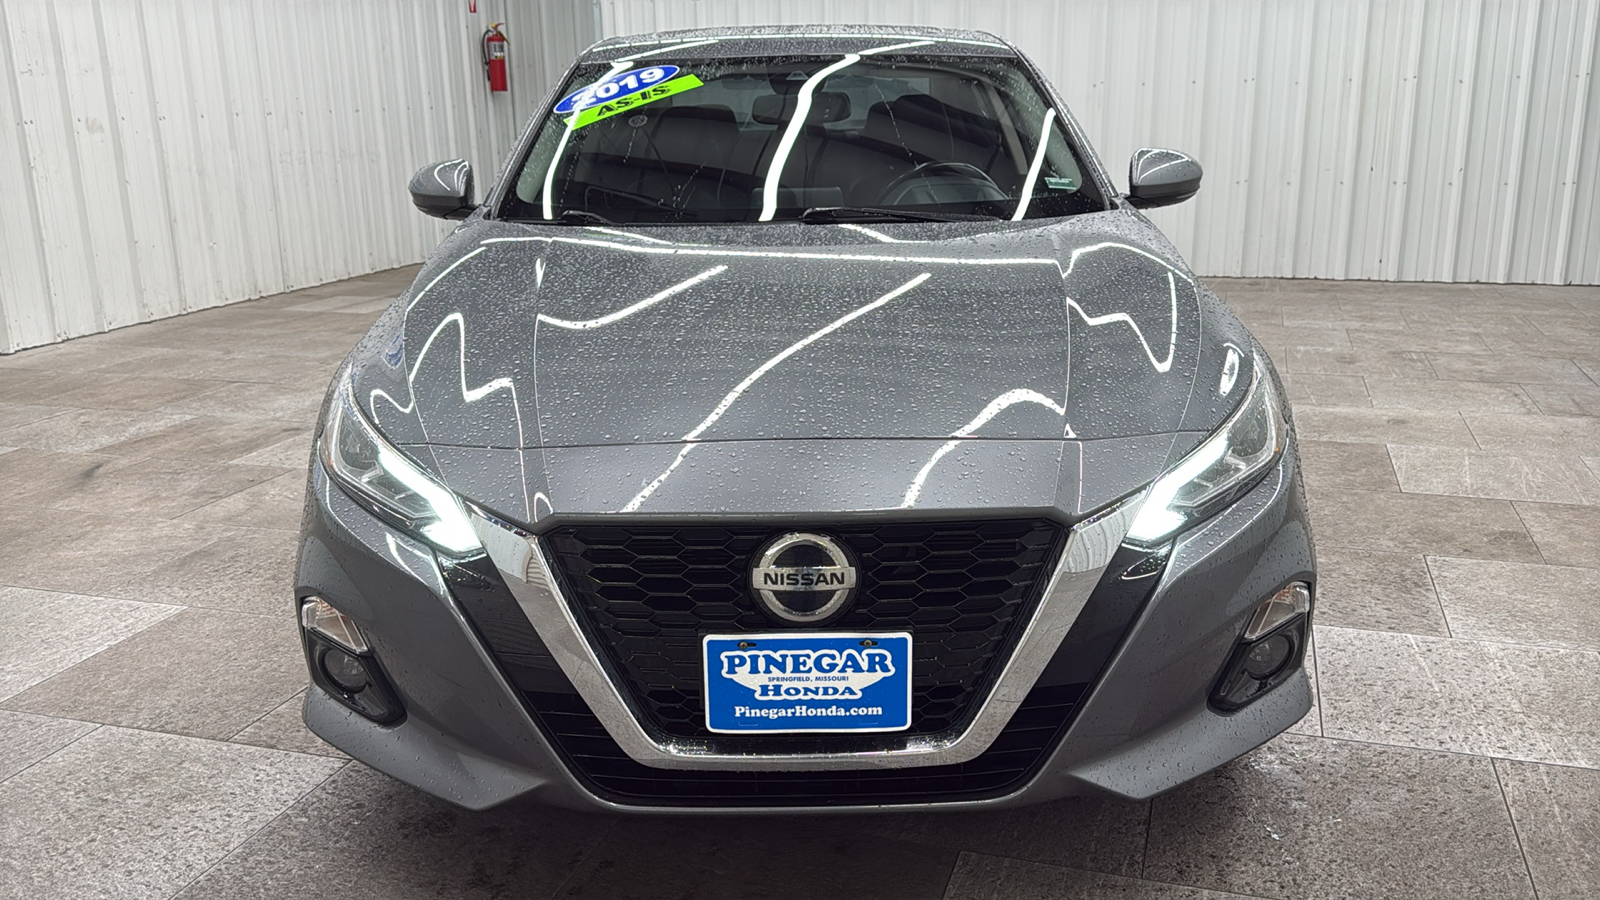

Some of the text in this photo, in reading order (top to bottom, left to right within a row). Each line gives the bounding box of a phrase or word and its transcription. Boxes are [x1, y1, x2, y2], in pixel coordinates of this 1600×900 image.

[571, 67, 665, 110] 2019
[597, 85, 671, 117] AS-IS
[763, 572, 845, 586] NISSAN
[724, 653, 892, 675] PINEGAR
[758, 684, 858, 697] HONDA
[734, 705, 883, 719] PinegarHonda.com
